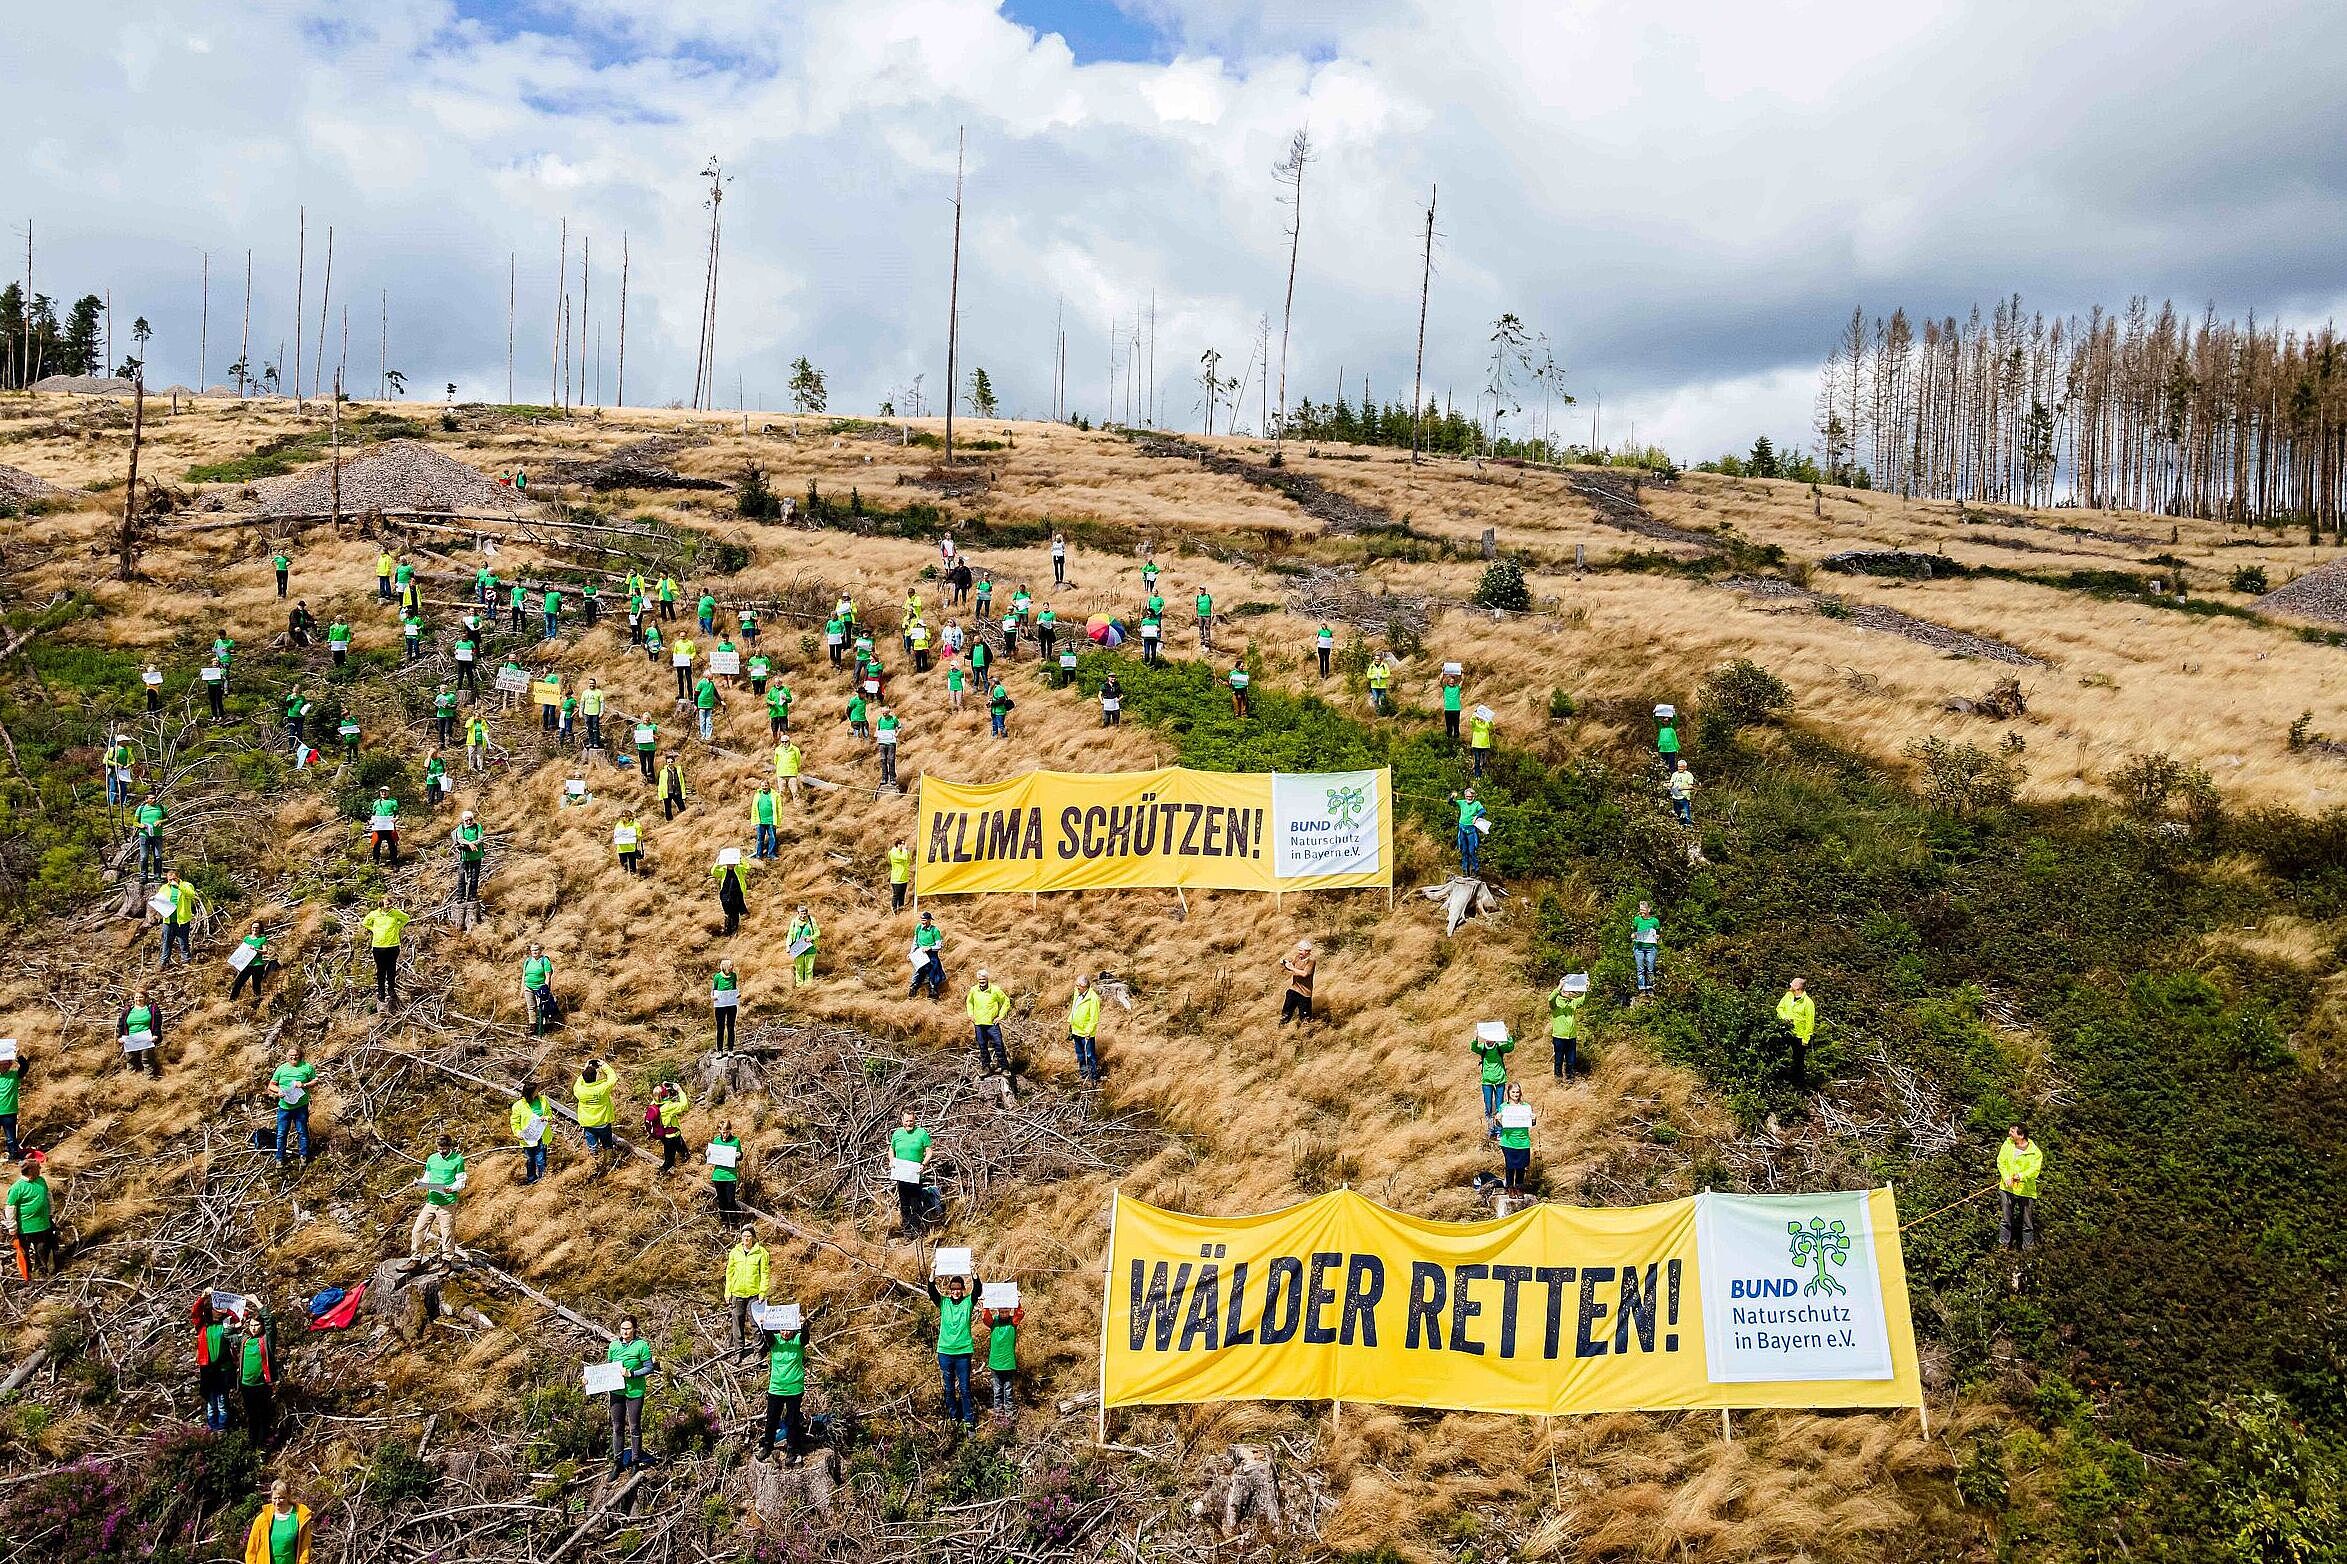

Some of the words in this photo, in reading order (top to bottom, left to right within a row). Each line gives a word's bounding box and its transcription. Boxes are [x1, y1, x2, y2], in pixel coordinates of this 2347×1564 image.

[927, 806, 1044, 863] KLIMA
[1057, 792, 1264, 860] SCHÜTZEN!
[1290, 820, 1331, 832] BUND
[1290, 834, 1360, 845] Naturschutz
[1291, 849, 1301, 860] in
[1304, 849, 1341, 861] Bayern
[1344, 846, 1361, 857] e.V.
[1731, 1278, 1798, 1299] BUND
[1129, 1243, 1385, 1352] WÄLDER
[1404, 1258, 1683, 1360] RETTEN!
[1733, 1304, 1851, 1325] Naturschutz
[1734, 1331, 1752, 1350] in
[1757, 1331, 1821, 1353] Bayern
[1827, 1329, 1856, 1348] e.V.
